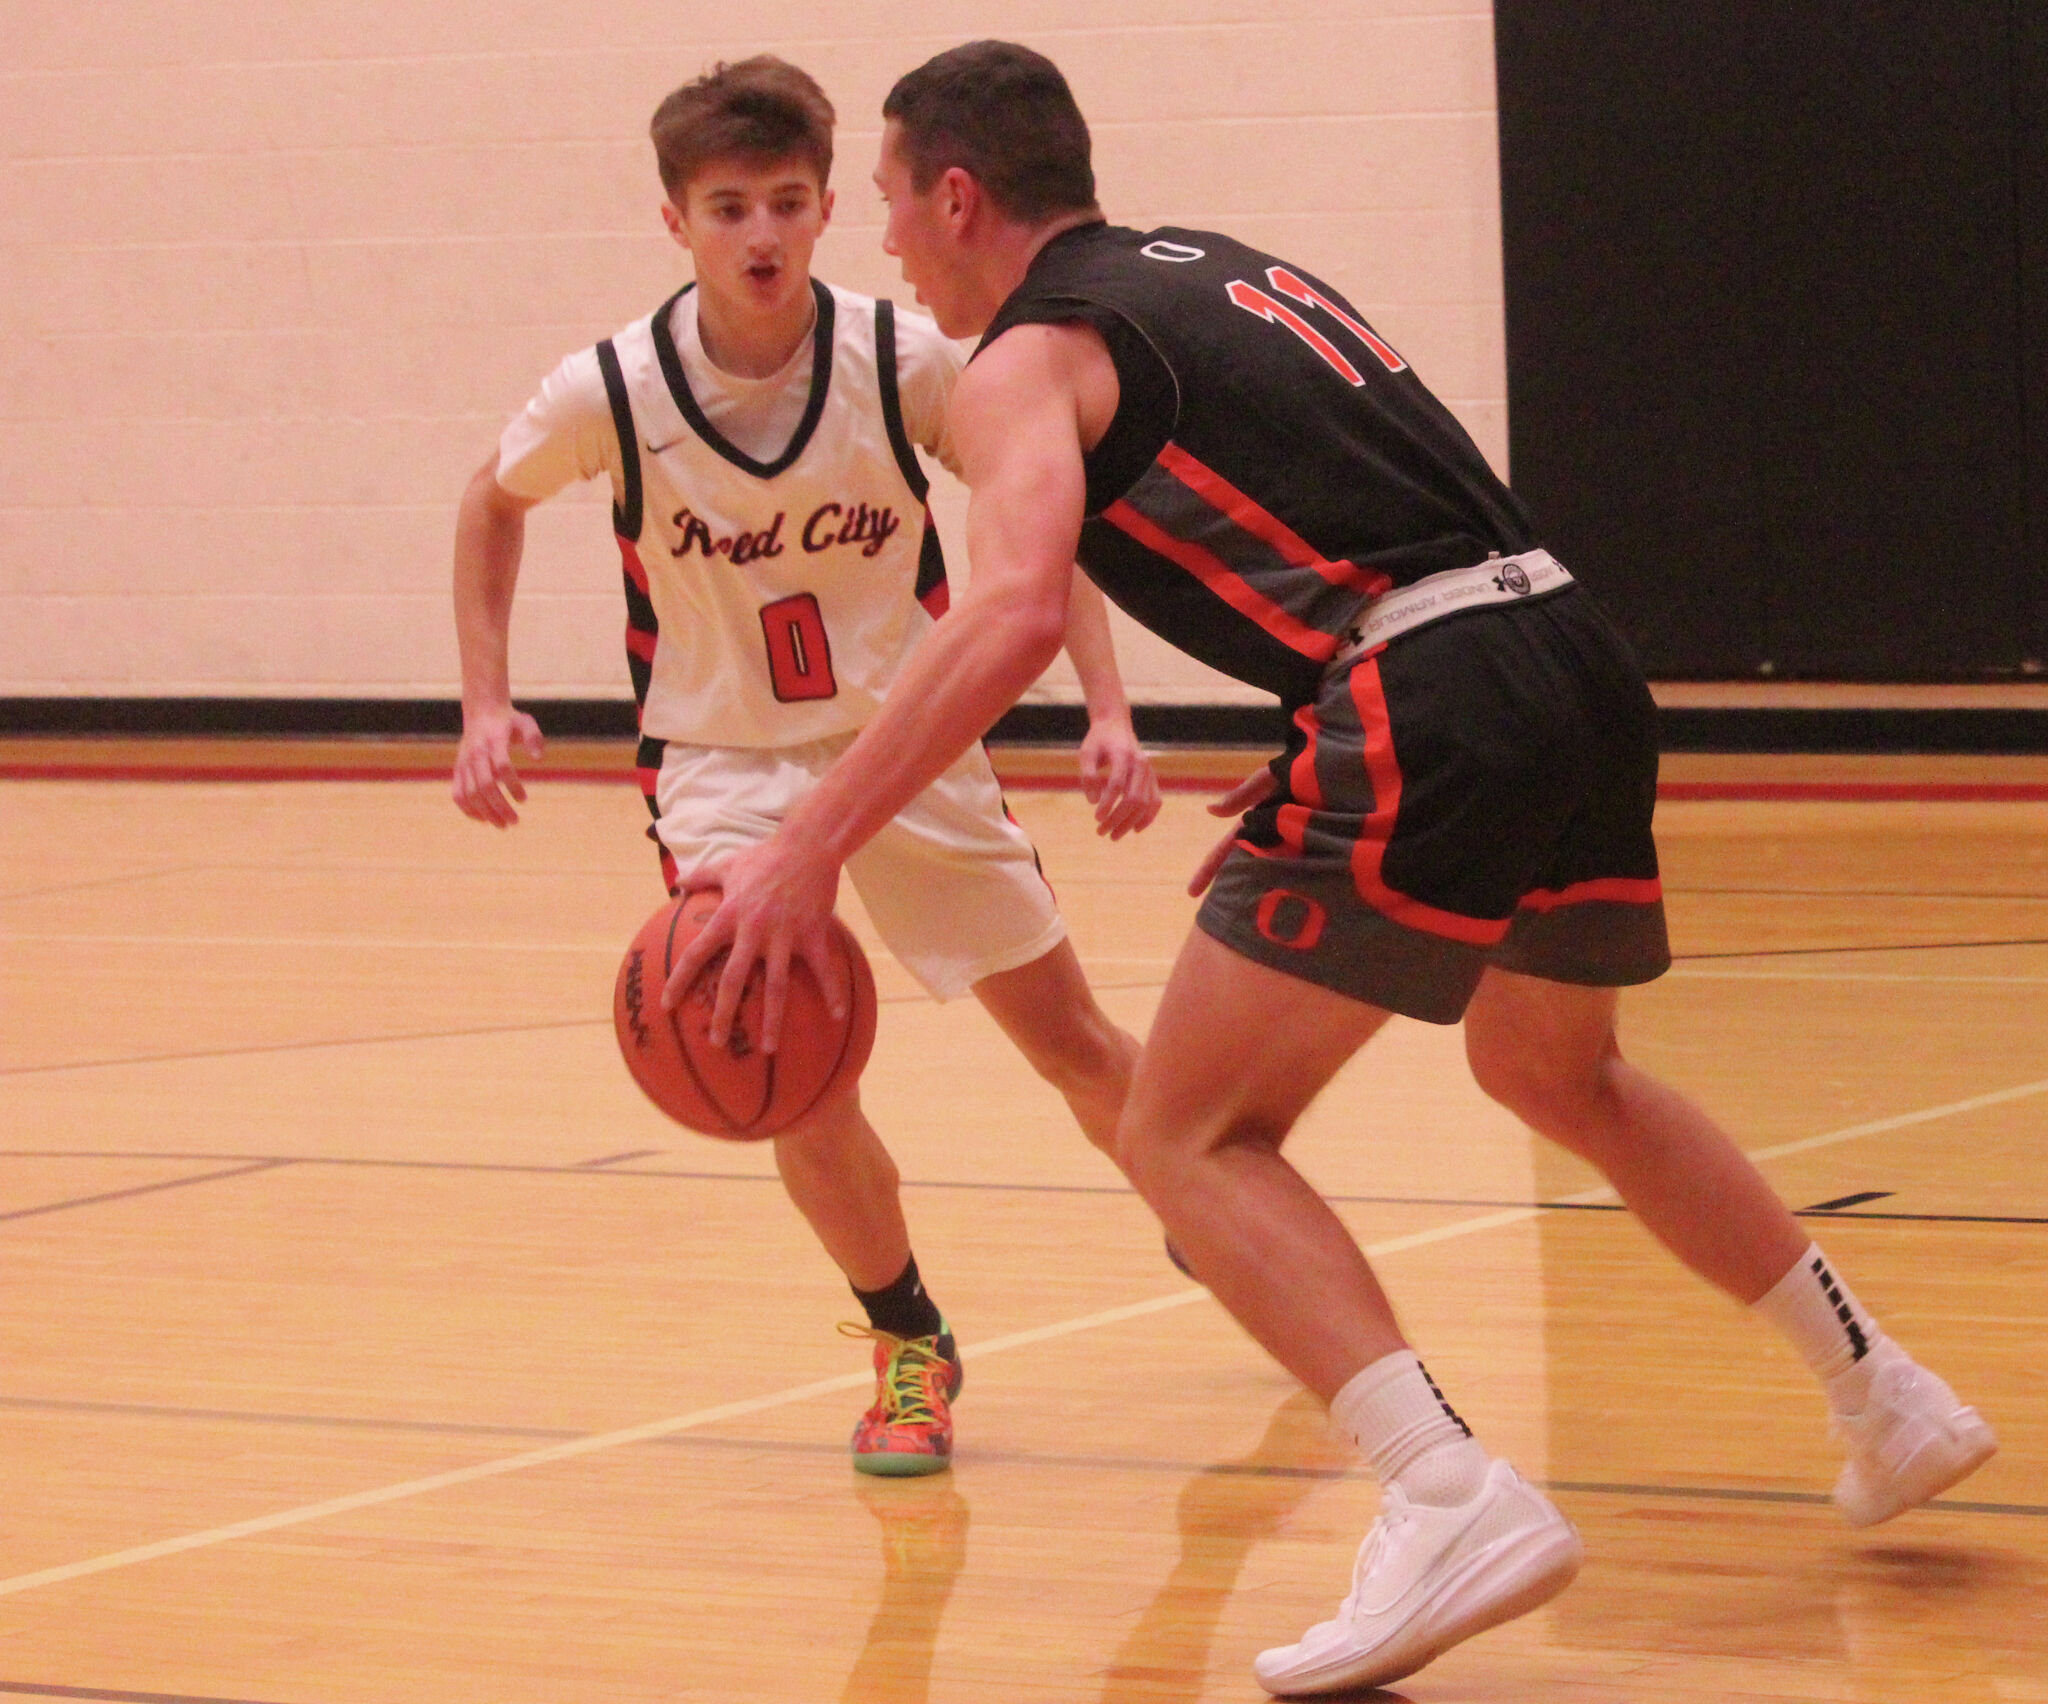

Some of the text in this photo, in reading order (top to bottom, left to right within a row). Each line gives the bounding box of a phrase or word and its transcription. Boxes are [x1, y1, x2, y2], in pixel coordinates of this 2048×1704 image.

[1225, 266, 1408, 387] 11
[802, 502, 900, 556] City
[759, 592, 837, 703] 0
[1368, 582, 1490, 633] UNDER ARMOUR
